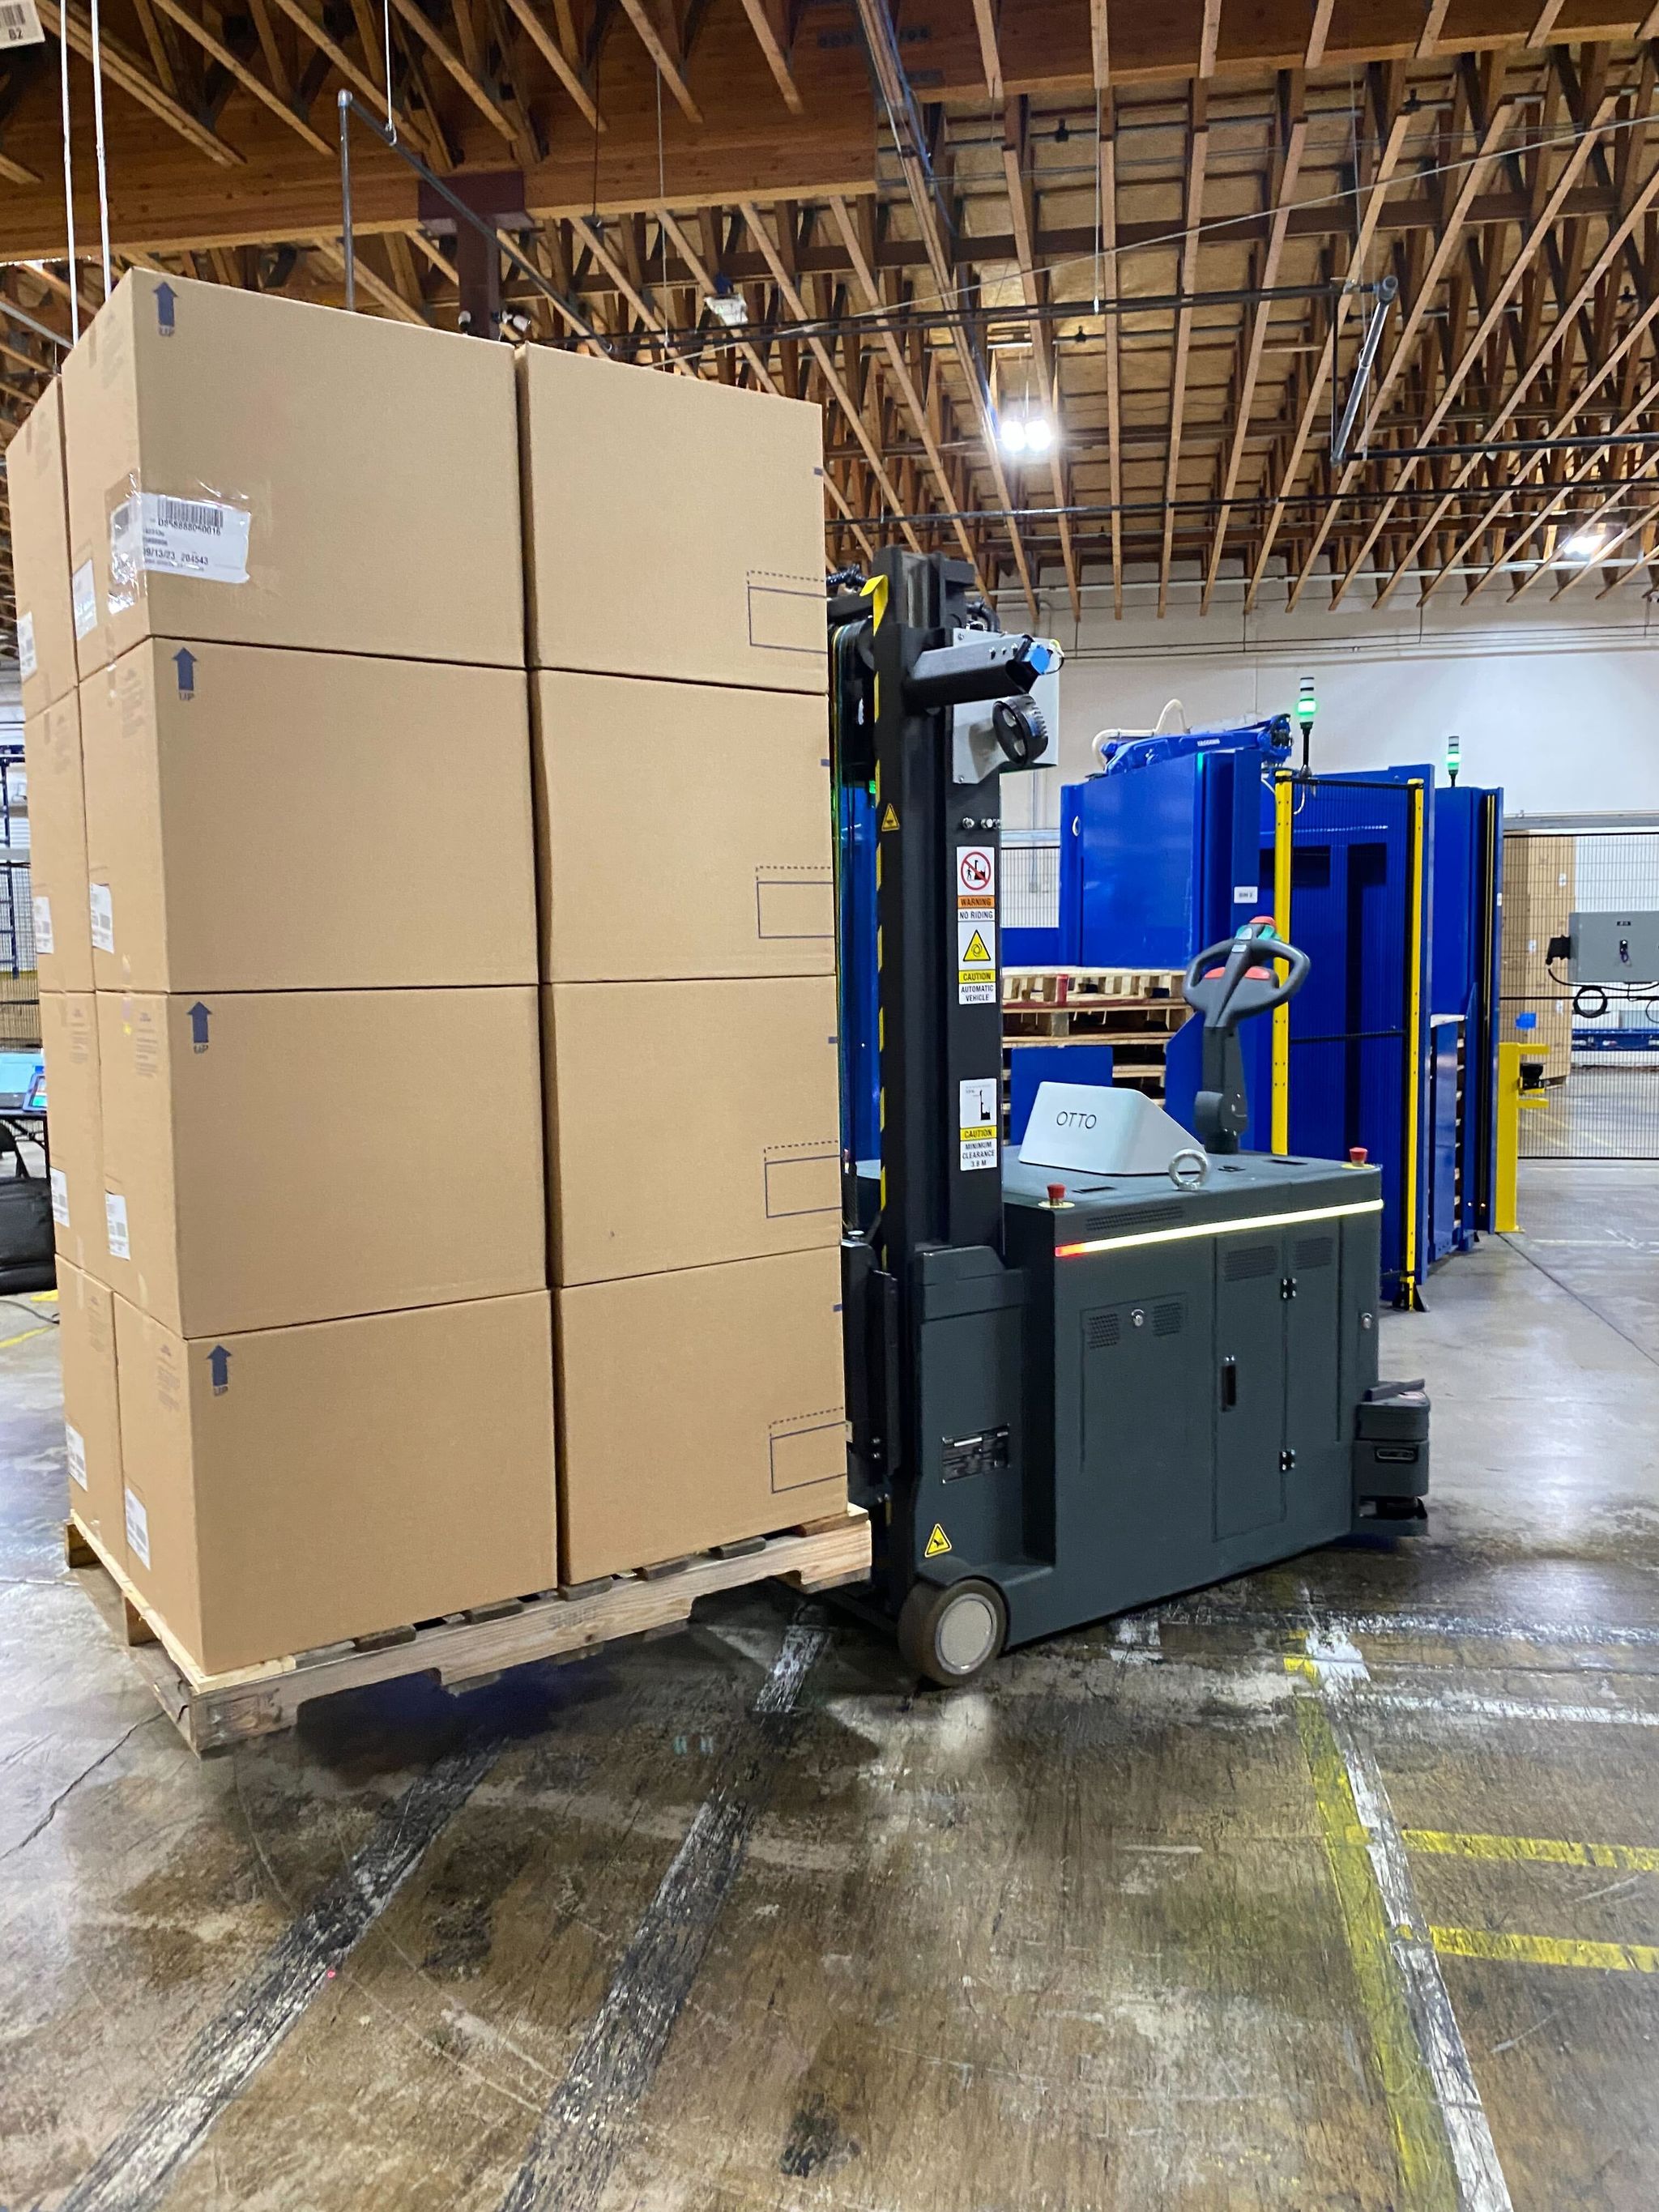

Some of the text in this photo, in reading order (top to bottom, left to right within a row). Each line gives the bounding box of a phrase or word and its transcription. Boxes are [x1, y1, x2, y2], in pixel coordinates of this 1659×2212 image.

[960, 911, 969, 919] NO
[963, 973, 991, 981] CAUTION
[962, 985, 994, 993] AUTOMATIC
[966, 994, 989, 1002] VEHICLE
[1056, 1110, 1097, 1129] OTTO
[965, 1129, 992, 1138] CAUTION
[966, 1141, 992, 1149] MINIMUM
[962, 1149, 994, 1159] CLEARANCE
